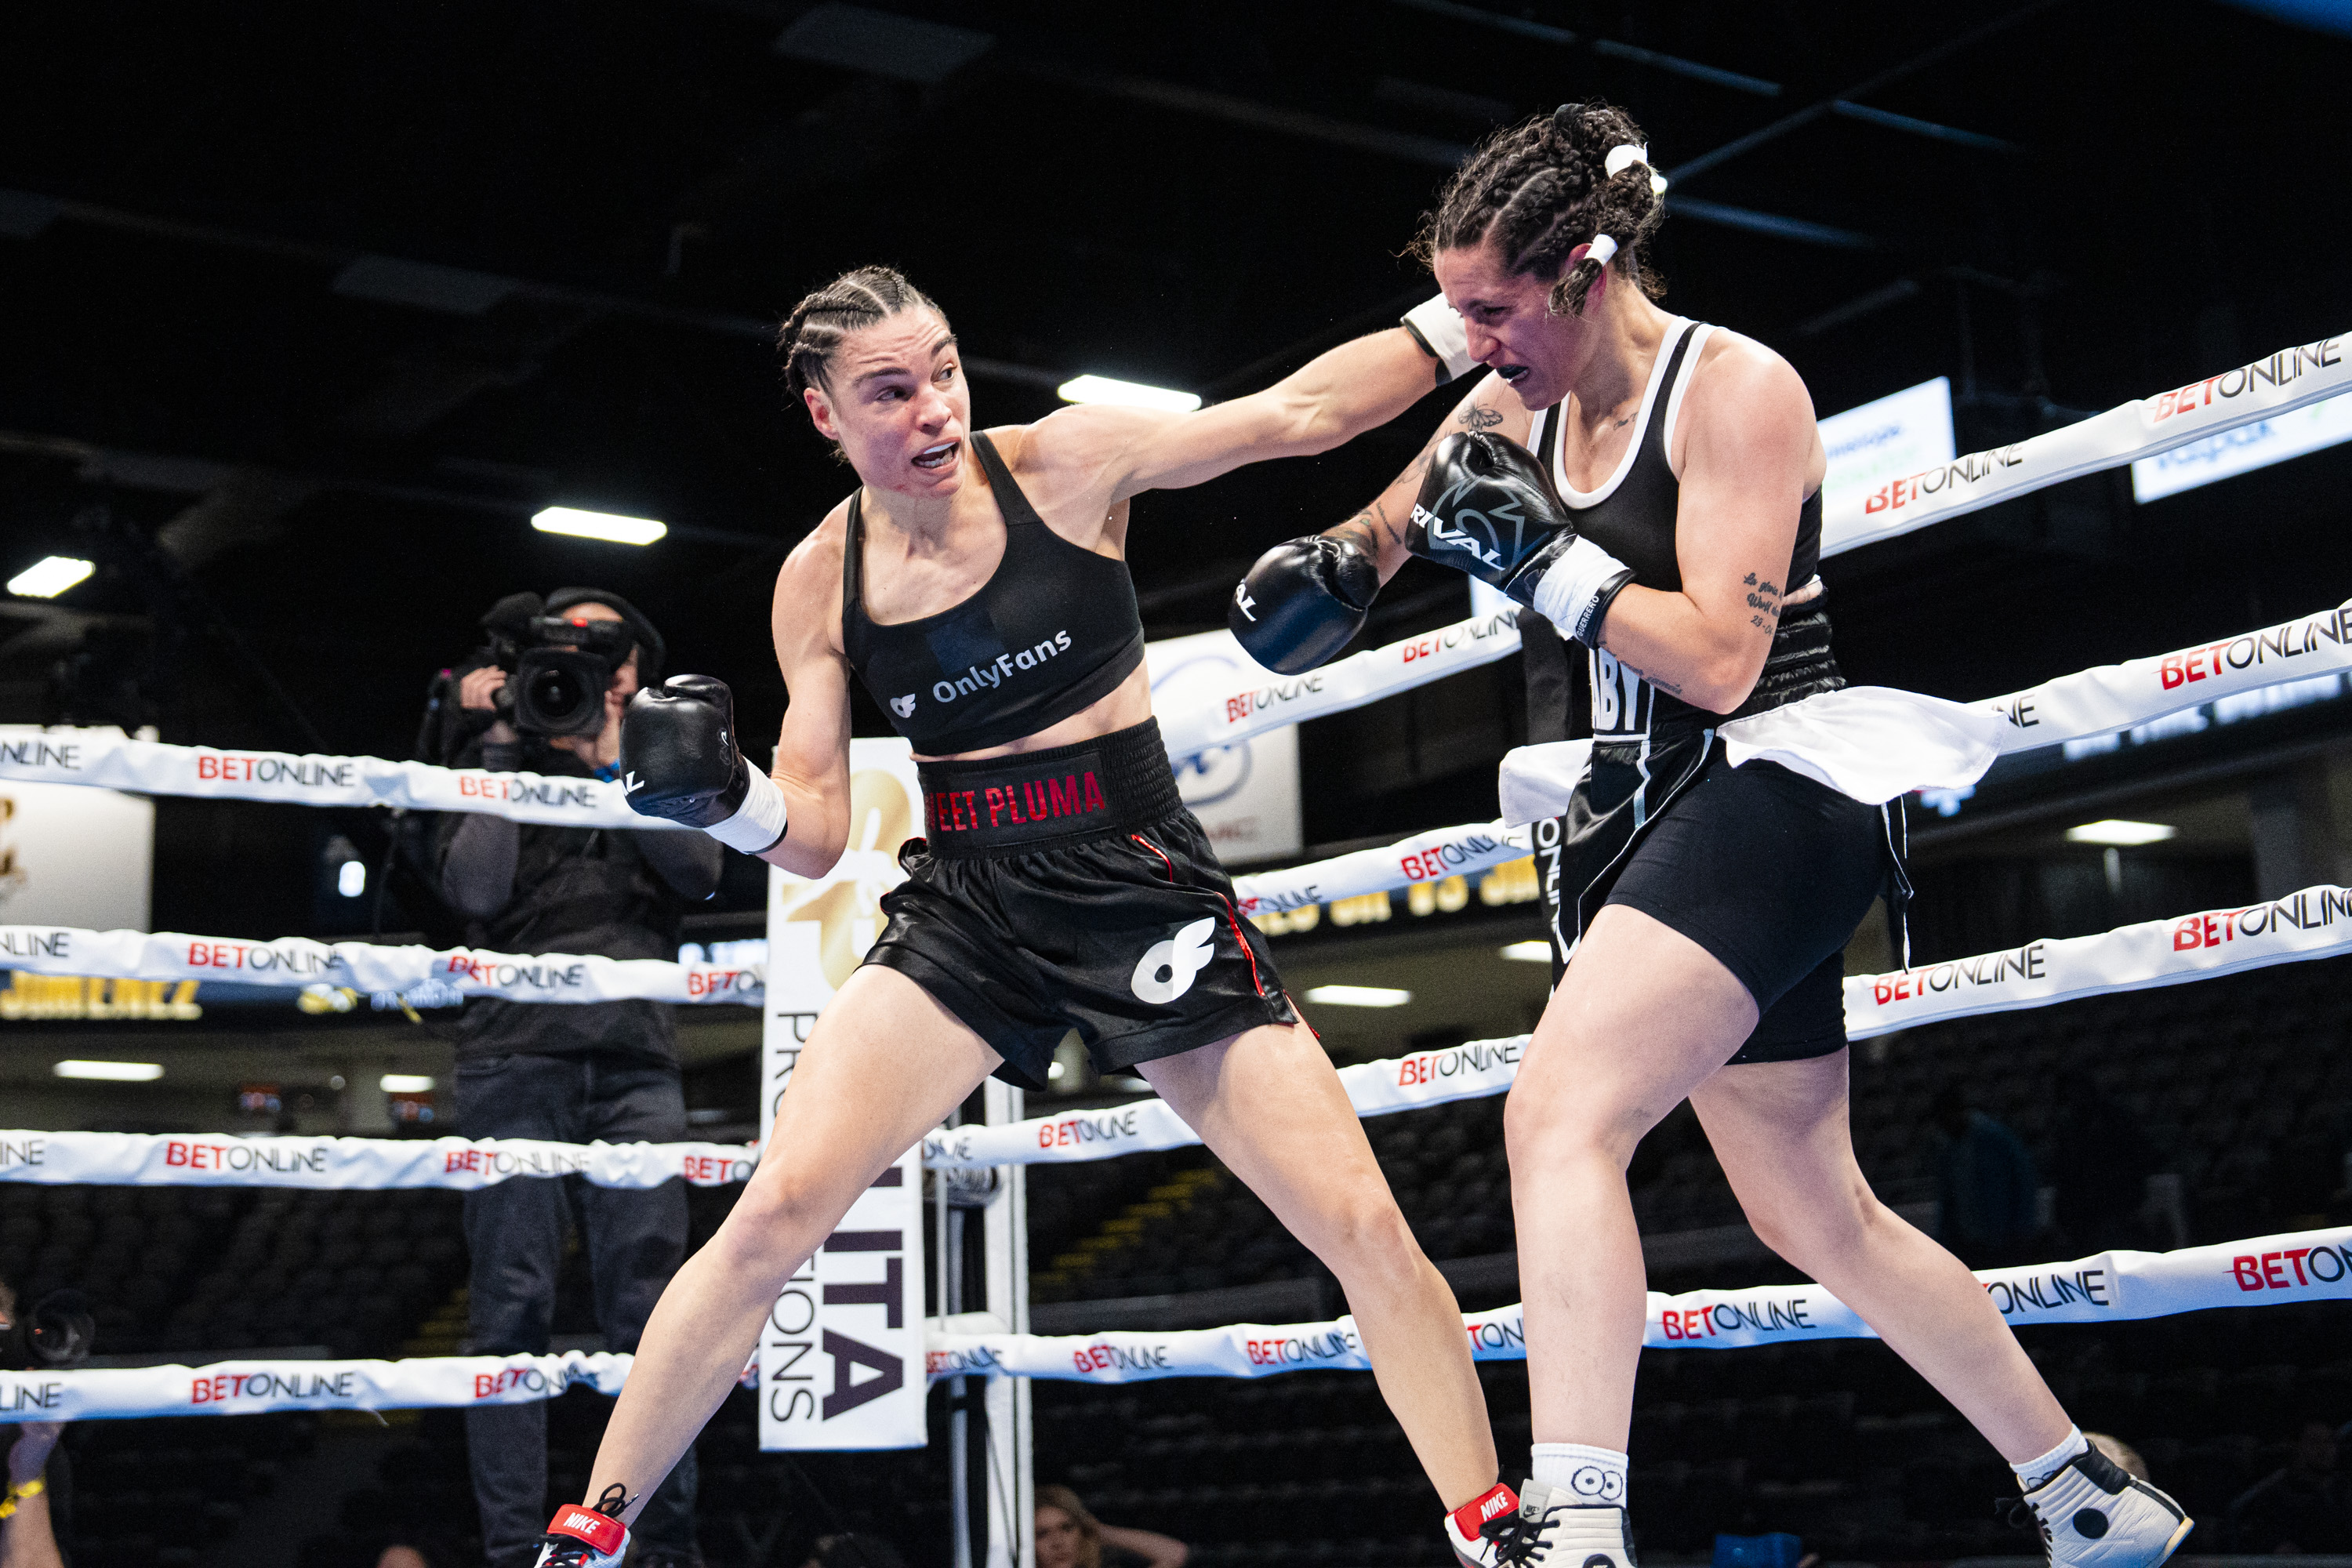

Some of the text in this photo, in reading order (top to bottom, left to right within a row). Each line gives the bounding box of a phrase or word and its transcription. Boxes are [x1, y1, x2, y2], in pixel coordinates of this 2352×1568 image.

[2153, 336, 2342, 424] BETONLINE
[1865, 439, 2024, 514] BETONLINE
[1410, 503, 1506, 572] RIVAL
[1576, 595, 1599, 637] GUERRERO
[933, 630, 1072, 703] OnlyFans
[2152, 607, 2352, 690] BETONLINE
[1226, 676, 1323, 723] BETONLINE
[198, 756, 355, 786] BETONLINE
[460, 775, 597, 808] BETONLINE
[985, 771, 1105, 828] PLUMA
[188, 942, 346, 974] BETONLINE
[1871, 943, 2047, 1006] BETONLINE
[1399, 1044, 1521, 1087] BETONLINE
[165, 1142, 328, 1172] BETONLINE
[444, 1149, 593, 1174] BETONLINE
[1982, 1269, 2110, 1316] ONLINE
[1658, 1298, 1817, 1340] BETONLINE
[1073, 1345, 1172, 1374] BETONLINE
[191, 1372, 355, 1404] BETONLINE
[563, 1512, 601, 1535] NIKE
[1480, 1491, 1508, 1523] NIKE
